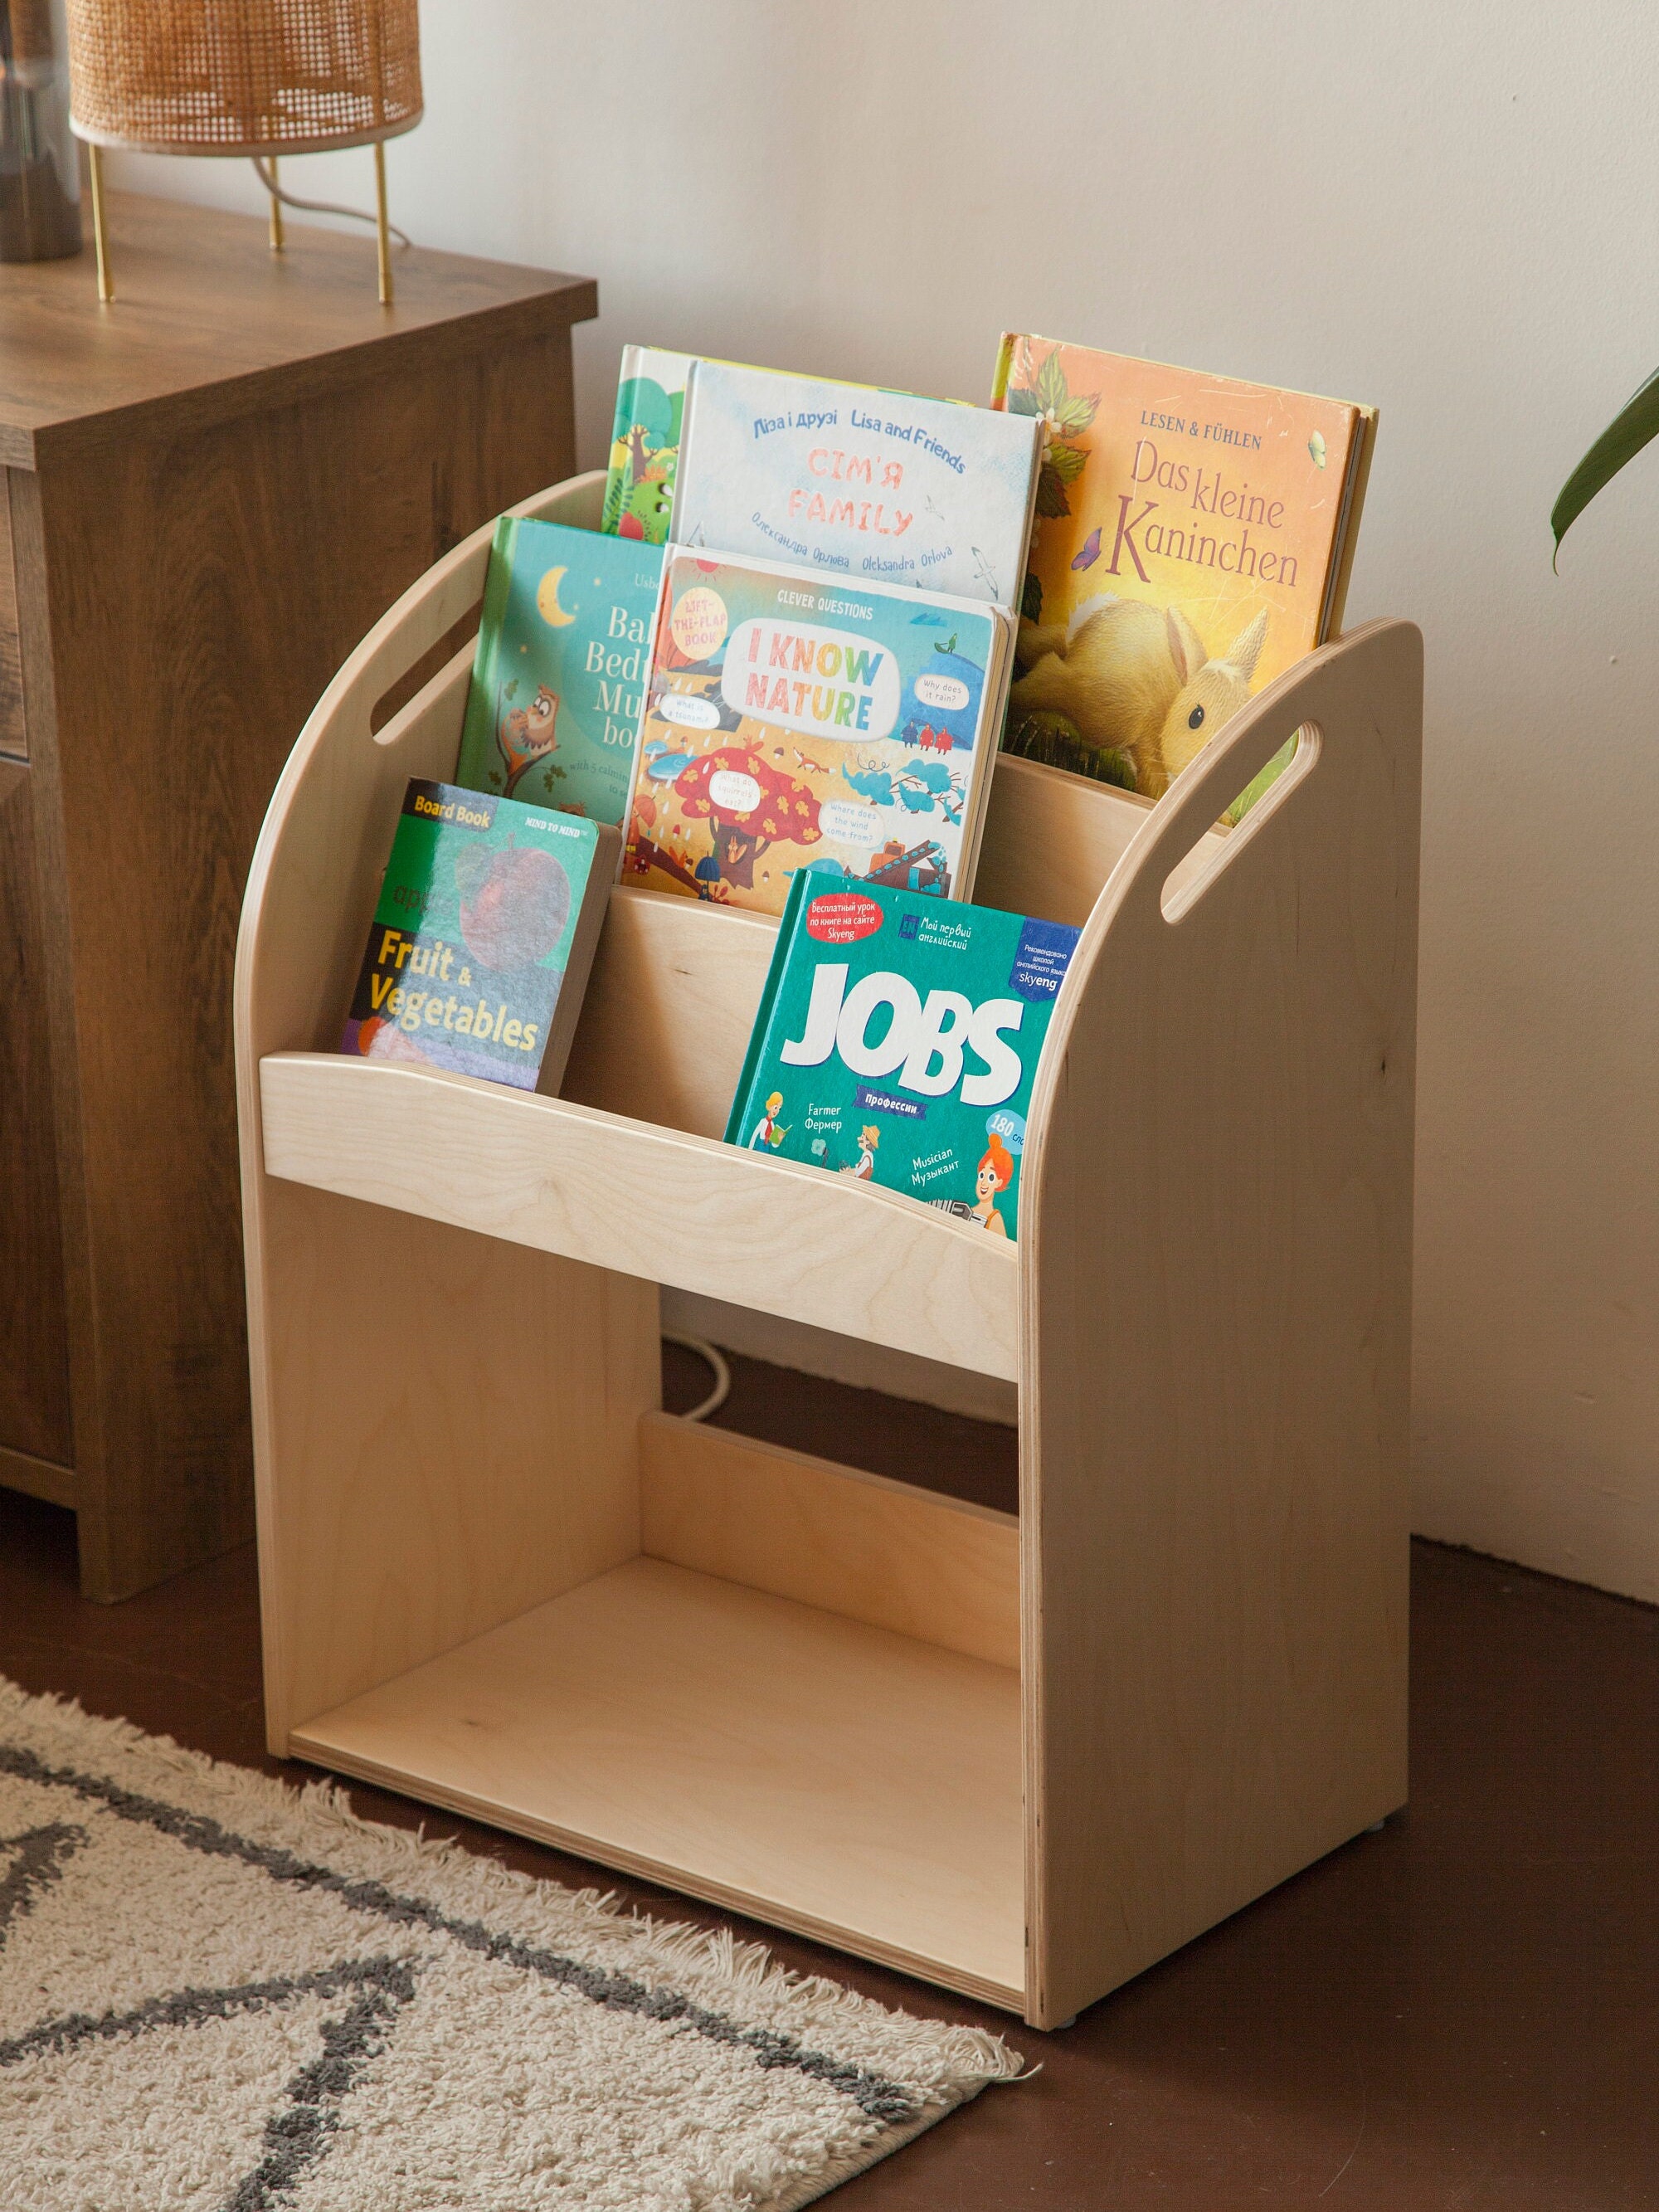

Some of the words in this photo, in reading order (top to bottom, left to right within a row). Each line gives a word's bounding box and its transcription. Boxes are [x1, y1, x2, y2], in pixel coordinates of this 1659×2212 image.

[753, 417, 785, 439] Ліза
[788, 412, 792, 427] і
[796, 410, 838, 429] друзі
[1141, 410, 1185, 434] LESEN
[1189, 420, 1200, 436] &
[1203, 423, 1262, 451] FÜHLEN
[851, 409, 881, 432] Lisa
[885, 420, 912, 441] and
[913, 428, 966, 475] Friends
[807, 447, 904, 490] СІМ'Я
[1130, 441, 1191, 492] Das
[1190, 468, 1285, 529] kleine
[789, 488, 913, 537] FAMILY
[752, 511, 808, 556] Олександра
[813, 547, 849, 568] Орлова
[1105, 494, 1300, 587] Kaninchen
[863, 555, 915, 572] Oleksandra
[921, 546, 953, 568] Orlova
[777, 589, 814, 609] CLEVER
[818, 597, 873, 621] QUESTIONS
[684, 631, 717, 646] BOOK
[748, 627, 761, 662] I
[769, 633, 883, 687] KNOW
[924, 680, 940, 690] Why
[943, 684, 961, 694] does
[936, 694, 956, 703] rain?
[745, 671, 873, 731] NATURE
[603, 716, 638, 748] bo
[599, 765, 630, 785] calmin
[415, 796, 455, 819] Board
[456, 806, 491, 828] Book
[830, 803, 854, 816] Where
[858, 810, 876, 820] does
[835, 816, 848, 825] the
[851, 821, 868, 831] wind
[525, 817, 546, 830] MIND
[547, 822, 558, 834] TO
[827, 828, 846, 837] come
[849, 831, 873, 842] from?
[811, 901, 855, 914] Бесплатный
[857, 903, 875, 915] урок
[820, 917, 841, 926] книге
[843, 917, 852, 925] на
[854, 914, 875, 925] сайте
[828, 928, 854, 941] Skyeng
[920, 917, 938, 931] Мой
[940, 923, 971, 938] первый
[918, 933, 967, 951] английский
[377, 930, 455, 981] Fruit
[458, 966, 471, 986] &
[1019, 972, 1058, 992] skyeng
[371, 974, 538, 1051] Vegetables
[780, 962, 1024, 1107] JOBS
[808, 1103, 841, 1116] Farmer
[864, 1093, 918, 1115] Профессии
[805, 1117, 842, 1134] Фермер
[990, 1113, 1015, 1138] 180
[912, 1148, 952, 1170] Musician
[911, 1161, 959, 1187] Музыкант
